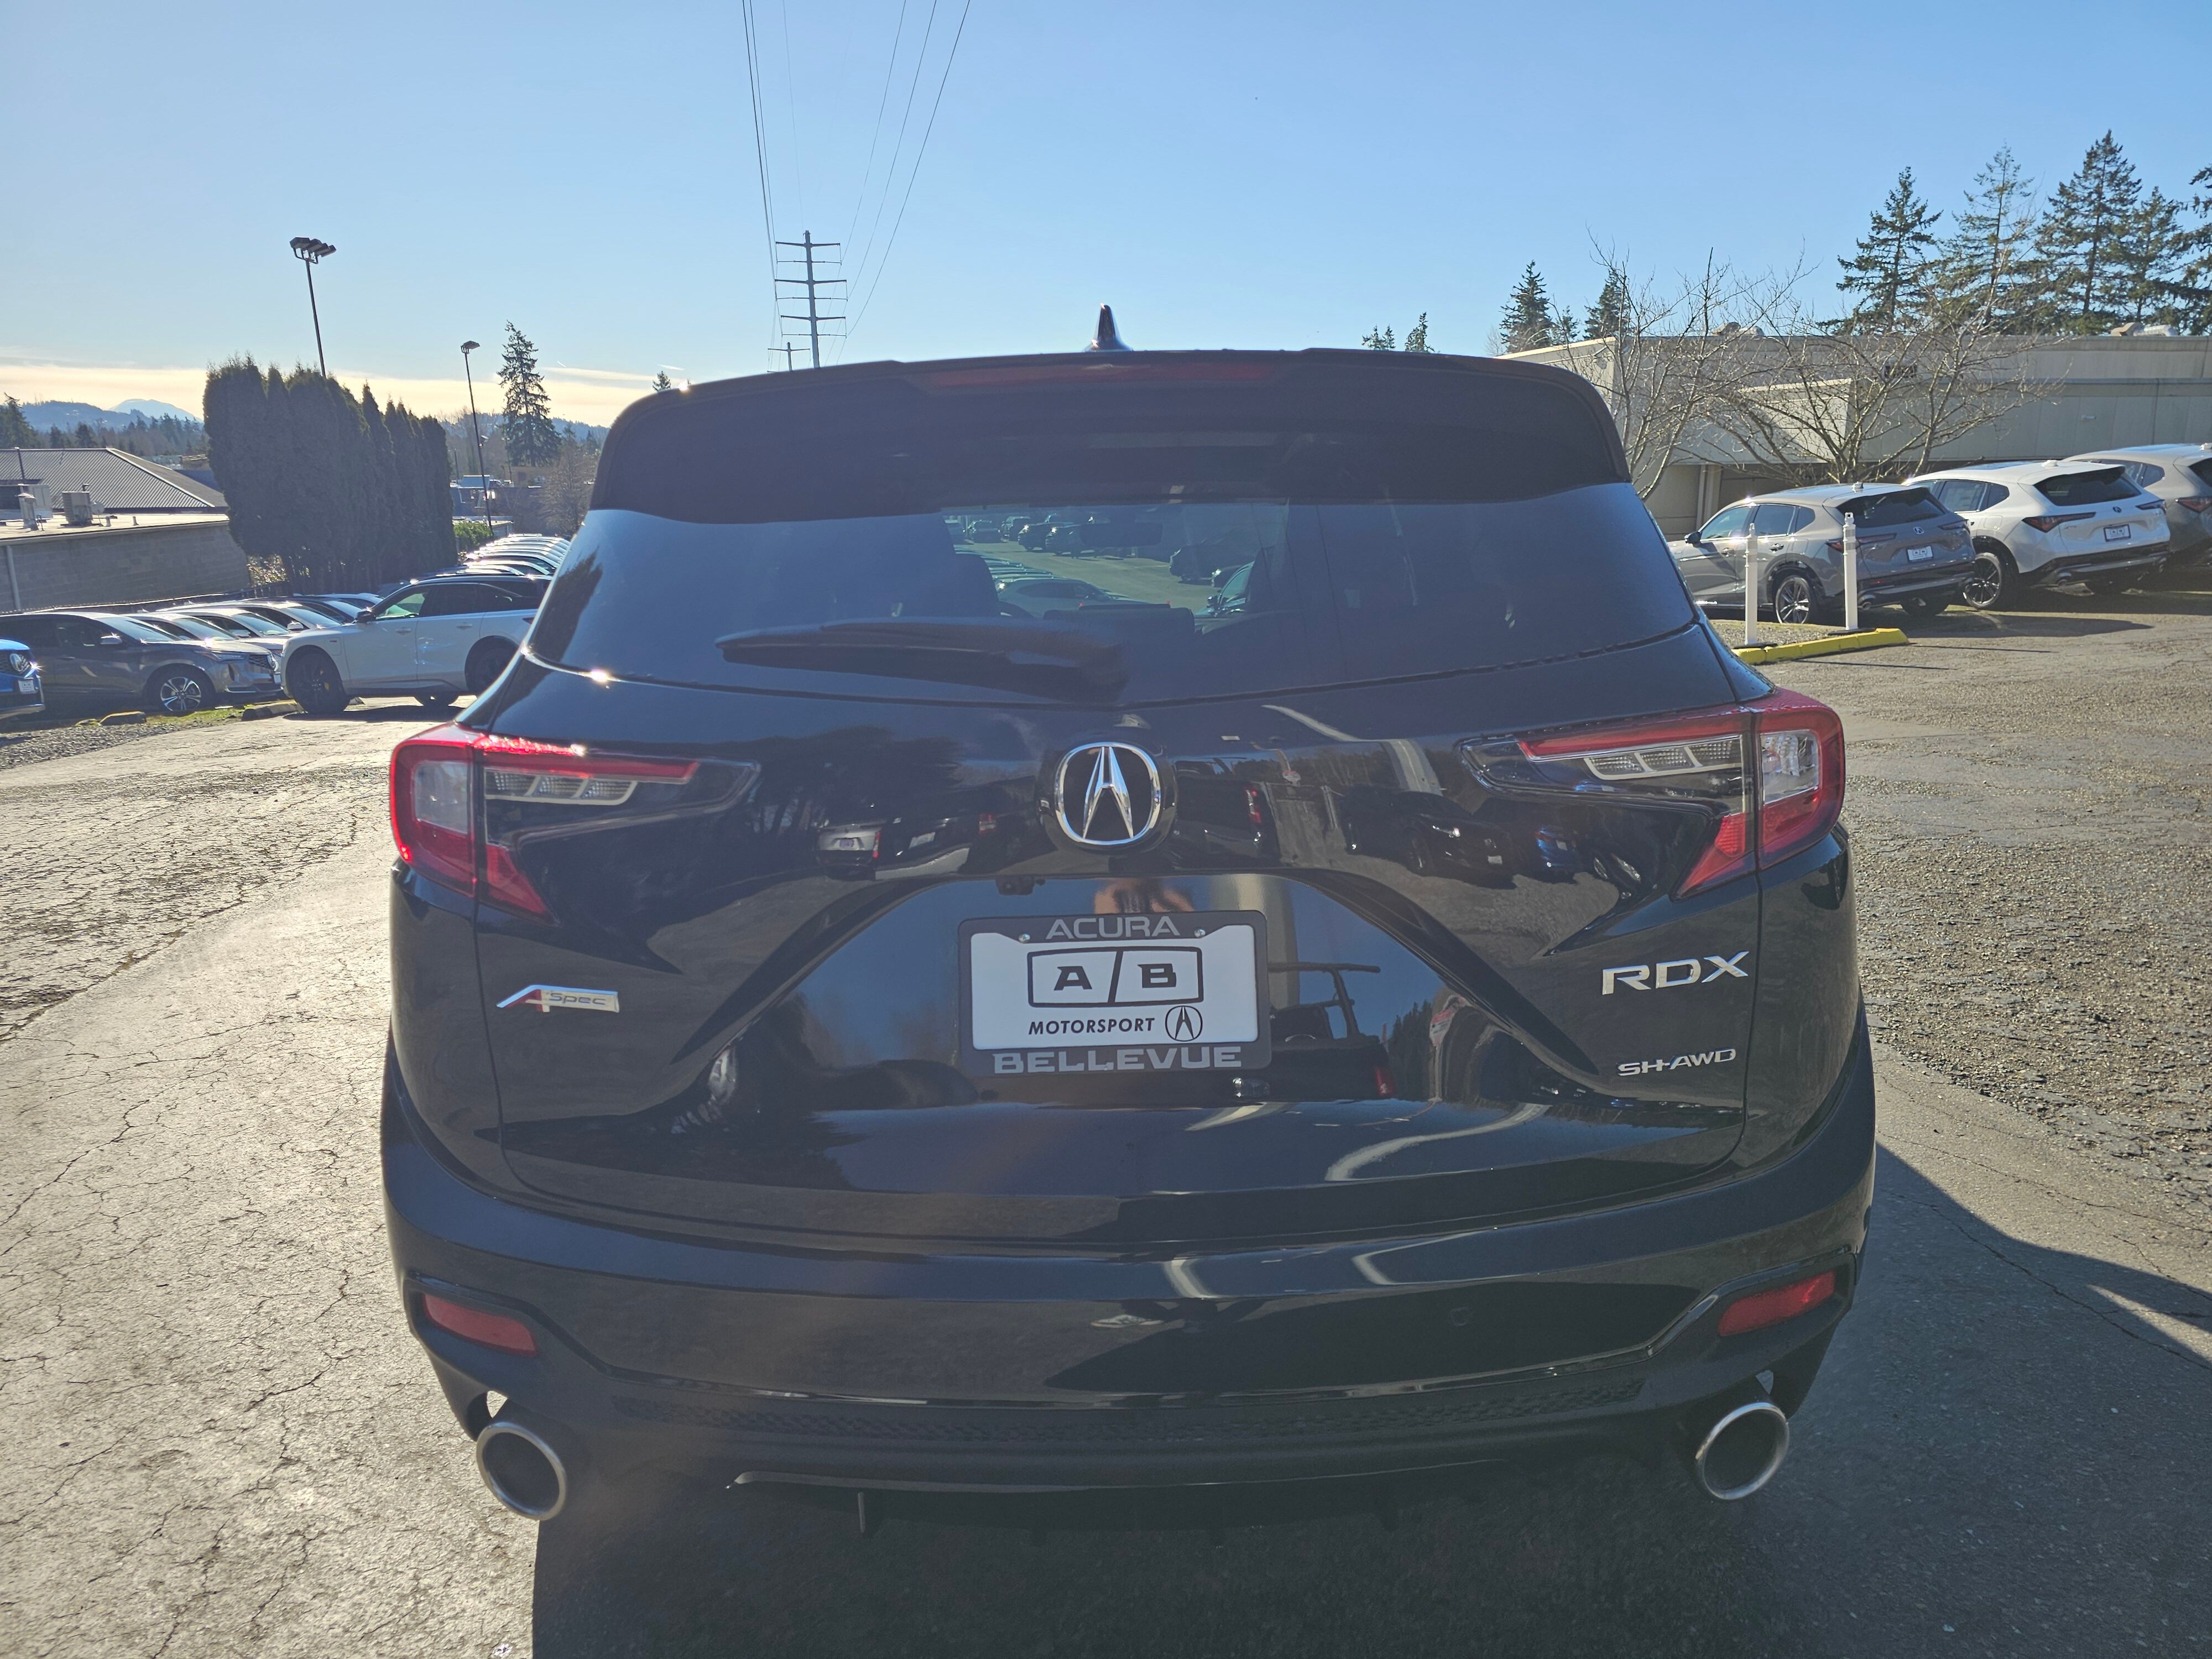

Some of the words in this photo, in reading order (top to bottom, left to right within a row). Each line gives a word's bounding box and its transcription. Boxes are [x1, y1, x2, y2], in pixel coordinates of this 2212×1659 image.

[1046, 916, 1180, 940] ACURA
[1602, 951, 1750, 995] RDX
[1028, 1018, 1155, 1035] MOTORSPORT
[993, 1046, 1241, 1073] BELLEVUE
[1617, 1048, 1736, 1076] SH-AWD
